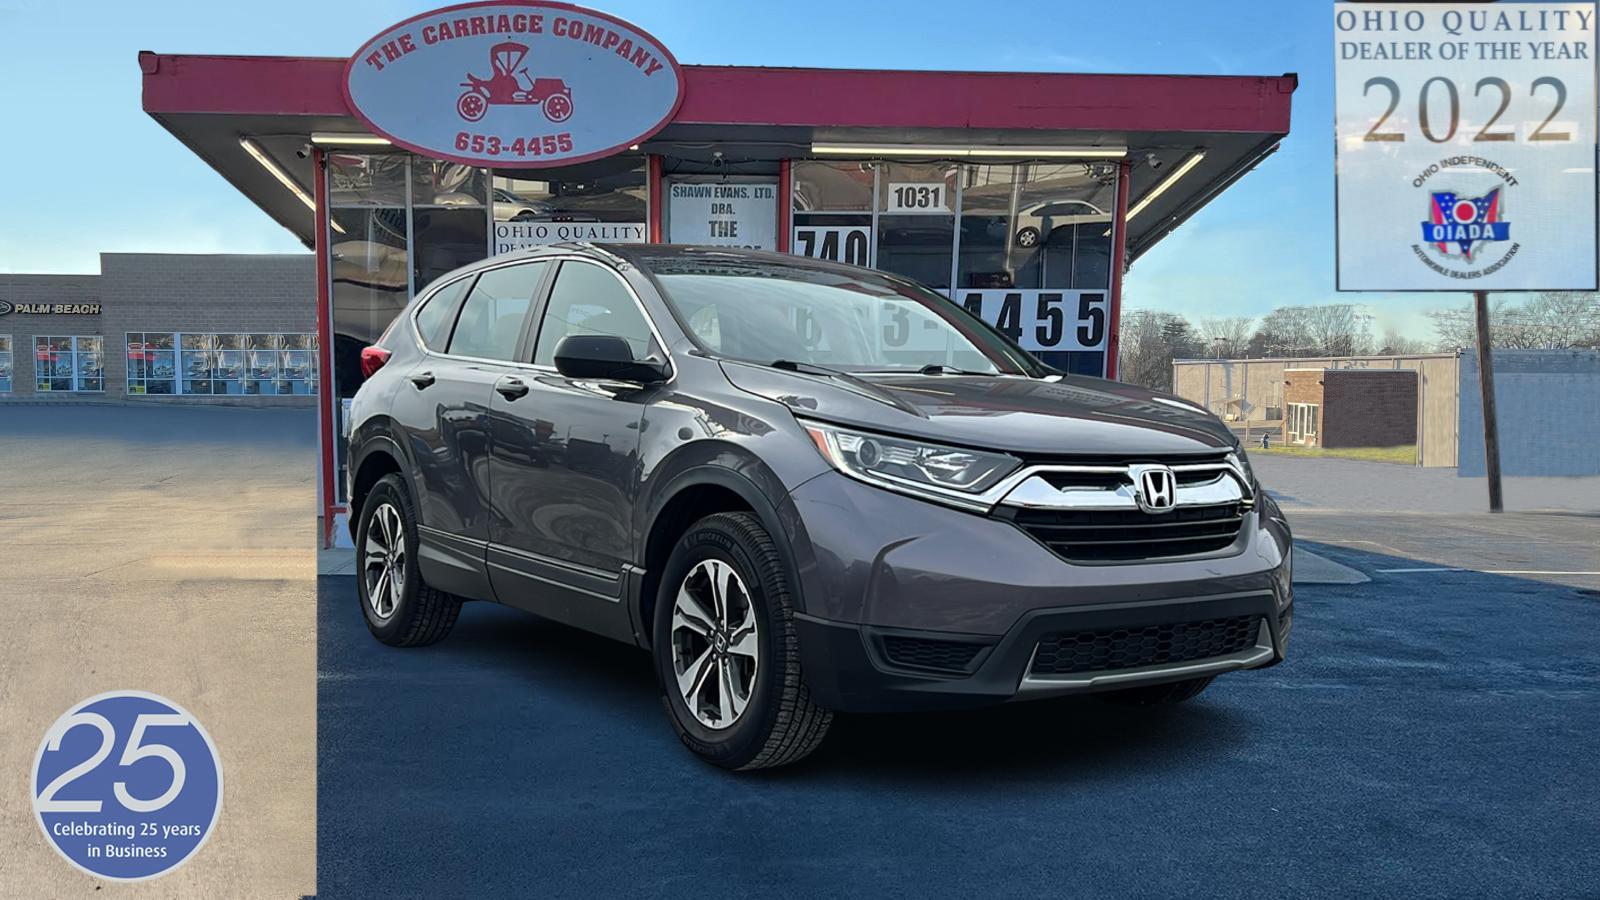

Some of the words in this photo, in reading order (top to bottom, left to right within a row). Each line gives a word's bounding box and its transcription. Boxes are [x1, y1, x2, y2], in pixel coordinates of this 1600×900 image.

[1336, 10, 1425, 31] OHIO
[1442, 10, 1592, 36] QUALITY
[365, 33, 416, 71] THE
[422, 14, 543, 45] CARRIAGE
[552, 16, 665, 77] COMPANY
[1340, 42, 1433, 60] DEALER
[1439, 42, 1469, 60] OF
[1474, 42, 1521, 60] THE
[1528, 42, 1589, 60] YEAR
[1362, 76, 1571, 143] 2022
[454, 131, 573, 156] 653-4455
[1412, 163, 1440, 188] OHIO
[1440, 156, 1519, 187] INDEPENDENT
[673, 186, 711, 198] SHAWN
[754, 188, 775, 199] LTD.
[894, 187, 940, 208] 1031
[711, 203, 736, 215] DBA.
[497, 226, 548, 239] OHIO
[557, 227, 643, 240] QUALITY
[708, 221, 738, 238] THE
[1432, 224, 1495, 240] OIADA
[1410, 243, 1449, 276] AUTOMOBILE
[1450, 269, 1482, 279] DEALERS
[1482, 242, 1521, 276] ASSOCIATION
[14, 304, 50, 314] PALM
[54, 304, 100, 314] BEACH
